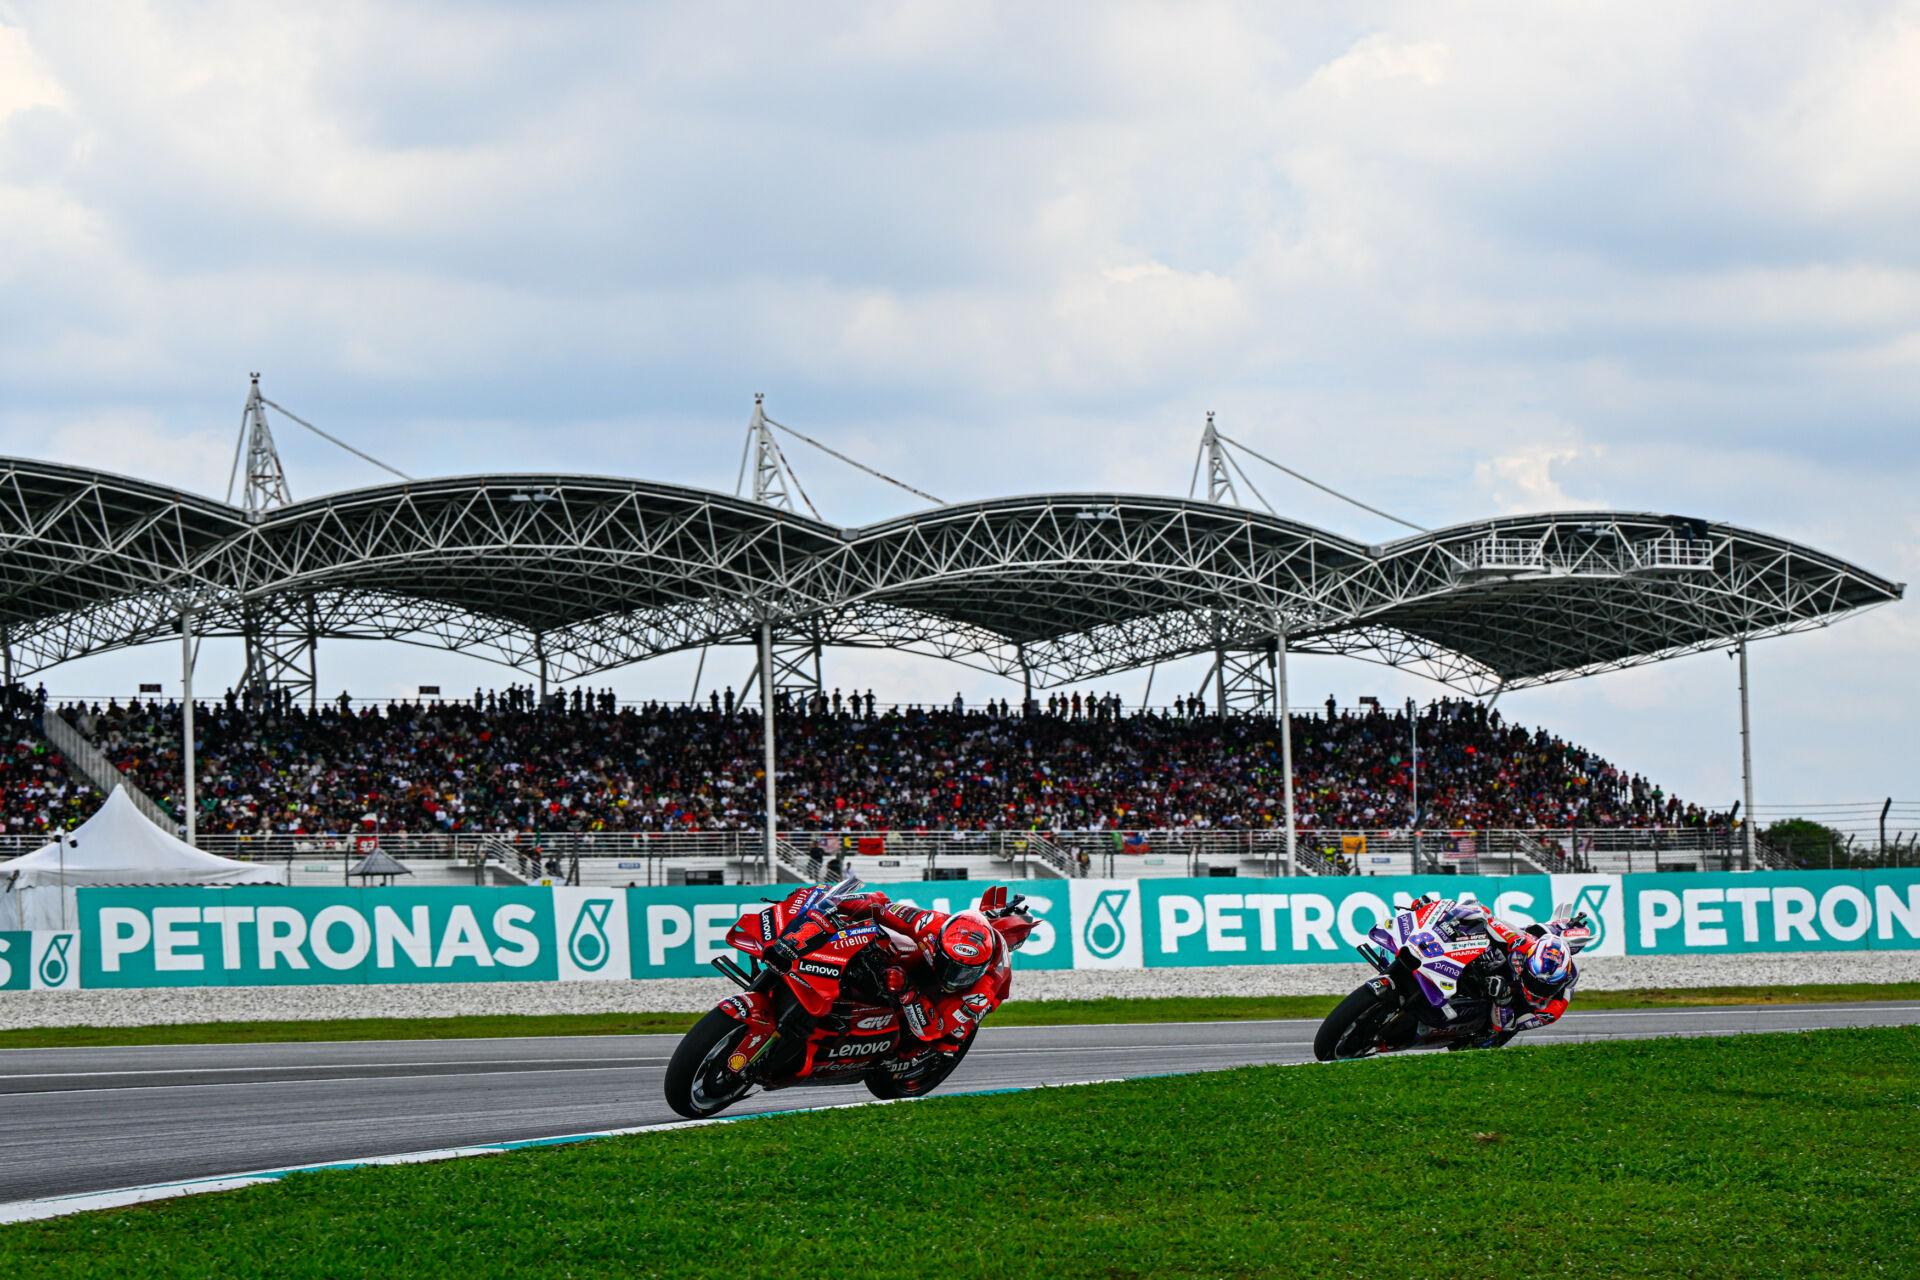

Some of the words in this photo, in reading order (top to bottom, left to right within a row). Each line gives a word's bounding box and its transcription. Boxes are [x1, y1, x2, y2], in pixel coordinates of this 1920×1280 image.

[761, 910, 772, 940] Lenovo
[1400, 914, 1411, 936] prima
[99, 903, 540, 972] PETRONAS
[783, 921, 822, 950] 1
[840, 934, 869, 949] riello
[1450, 949, 1480, 957] PRAMAC
[799, 961, 839, 976] Lenovo
[1434, 962, 1460, 977] prima
[914, 1003, 927, 1026] Lenovo
[828, 1040, 891, 1058] Lenovo
